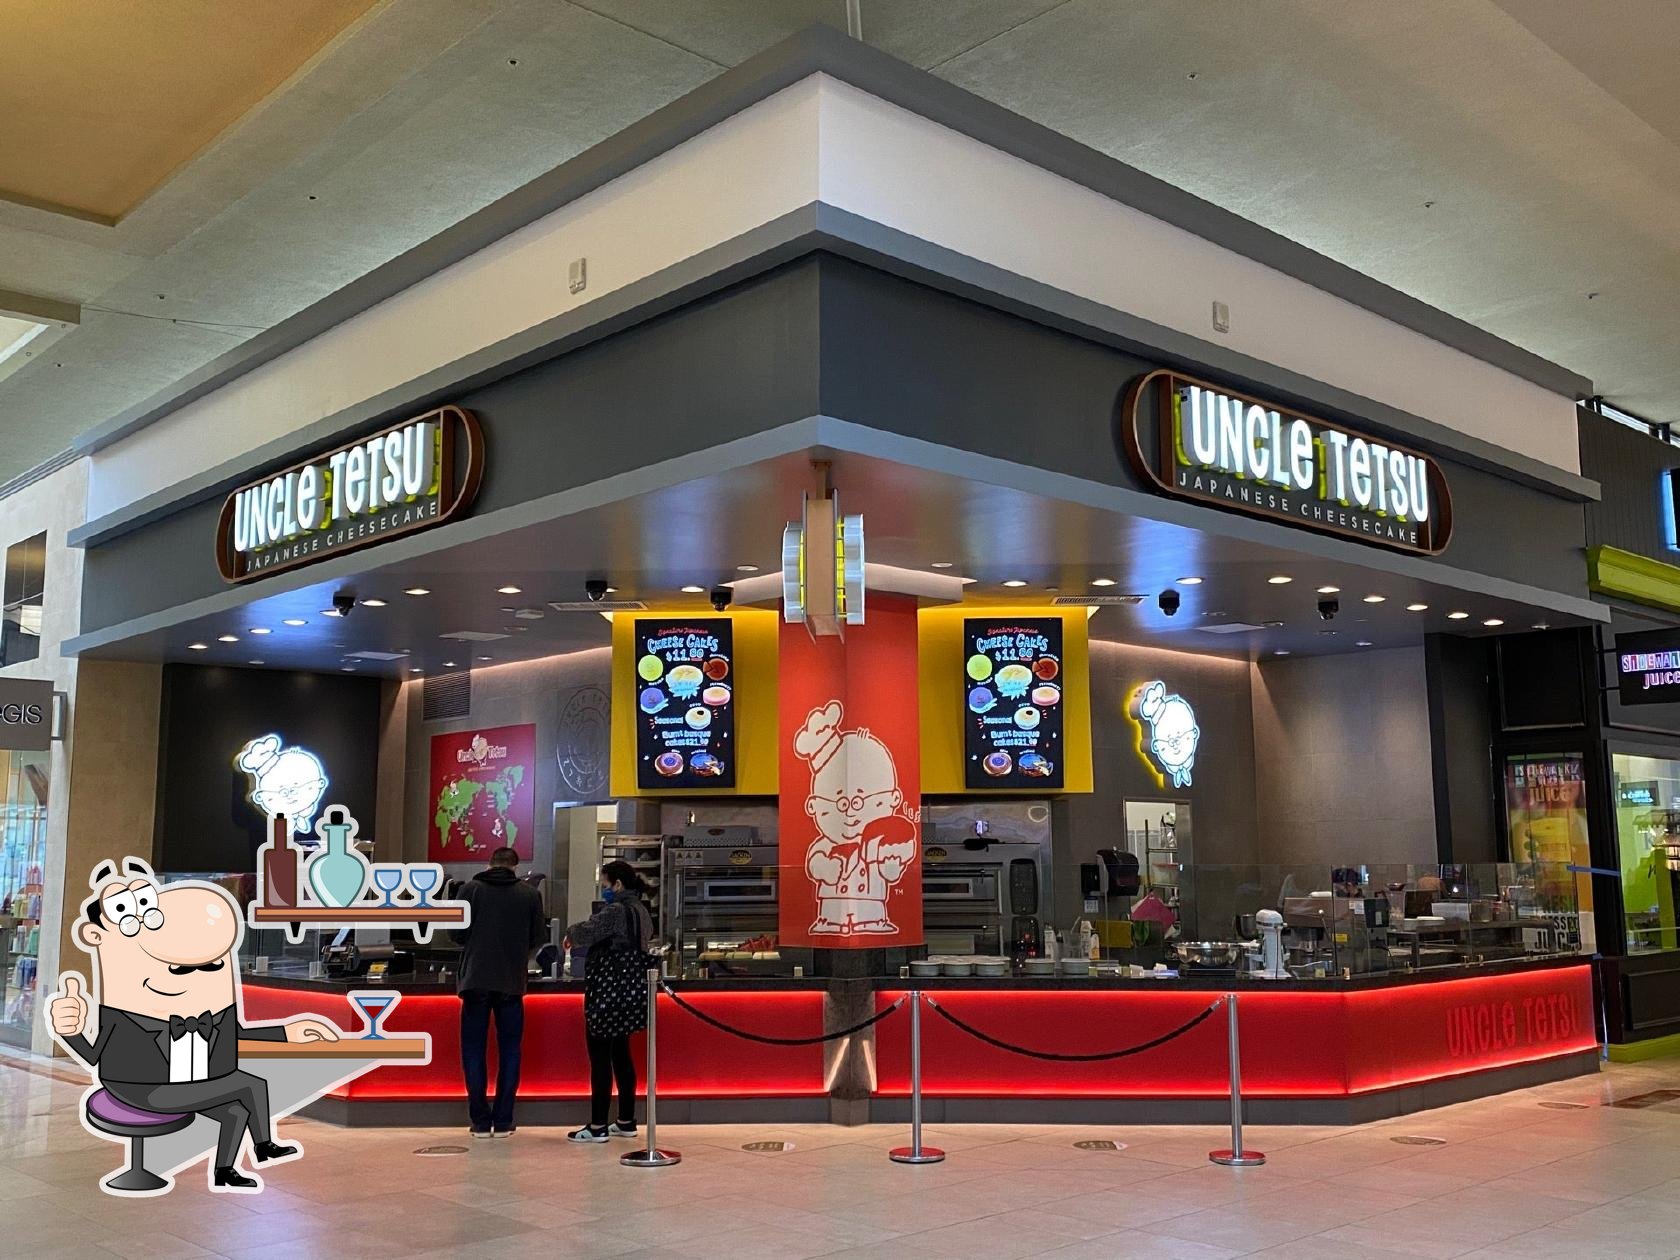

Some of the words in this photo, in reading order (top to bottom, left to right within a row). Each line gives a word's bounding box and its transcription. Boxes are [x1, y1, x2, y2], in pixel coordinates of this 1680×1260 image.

[246, 538, 318, 572] JAPANESE
[326, 501, 438, 547] CHEESECAKE
[1179, 472, 1289, 513] JAPANESE
[1301, 503, 1417, 545] CHEESECAKE
[0, 703, 42, 725] GIS
